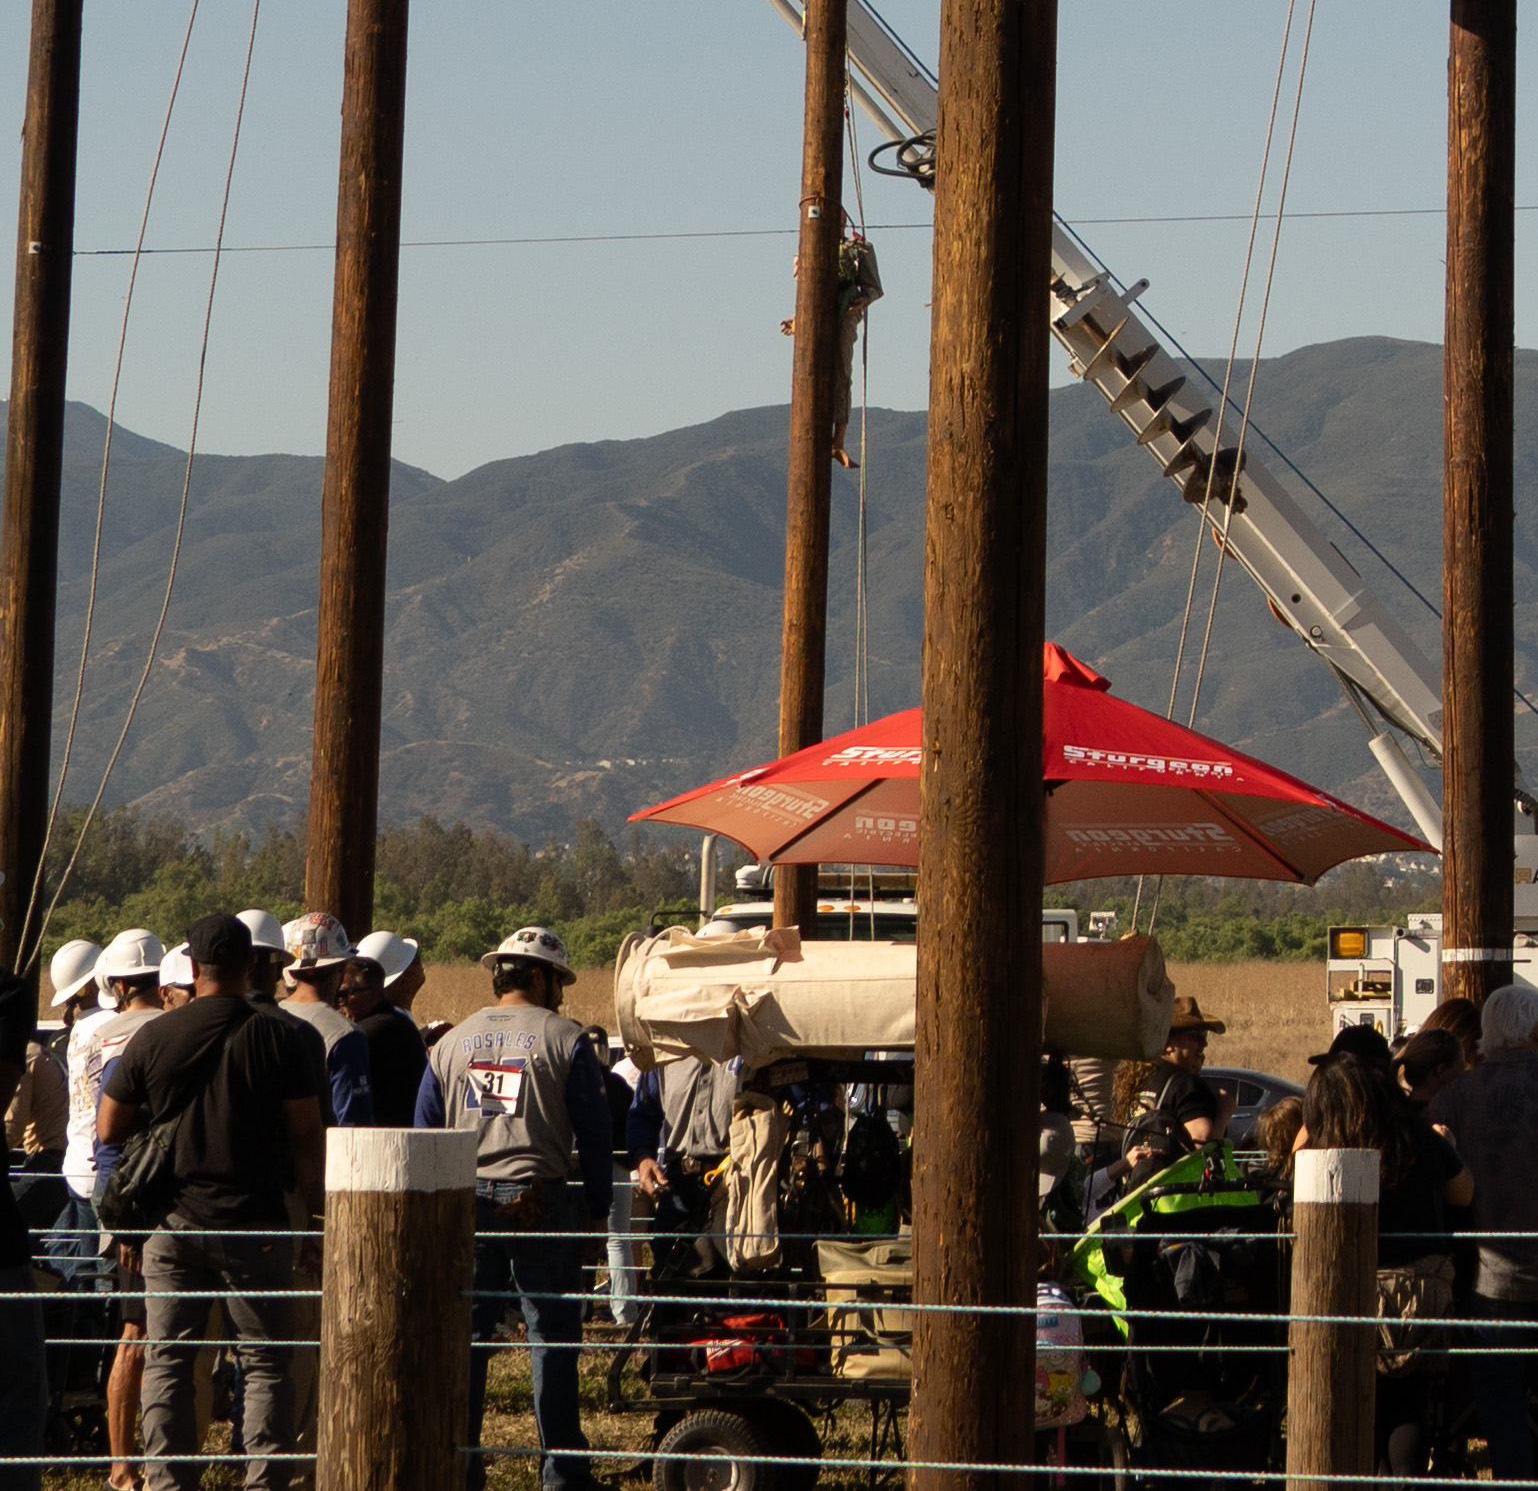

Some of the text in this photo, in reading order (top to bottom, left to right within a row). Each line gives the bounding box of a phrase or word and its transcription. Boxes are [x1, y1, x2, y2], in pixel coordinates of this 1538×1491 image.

[830, 745, 921, 759] Stur
[1063, 744, 1233, 775] Sturgeon
[462, 1031, 536, 1055] ROSALES
[482, 1071, 505, 1095] 31
